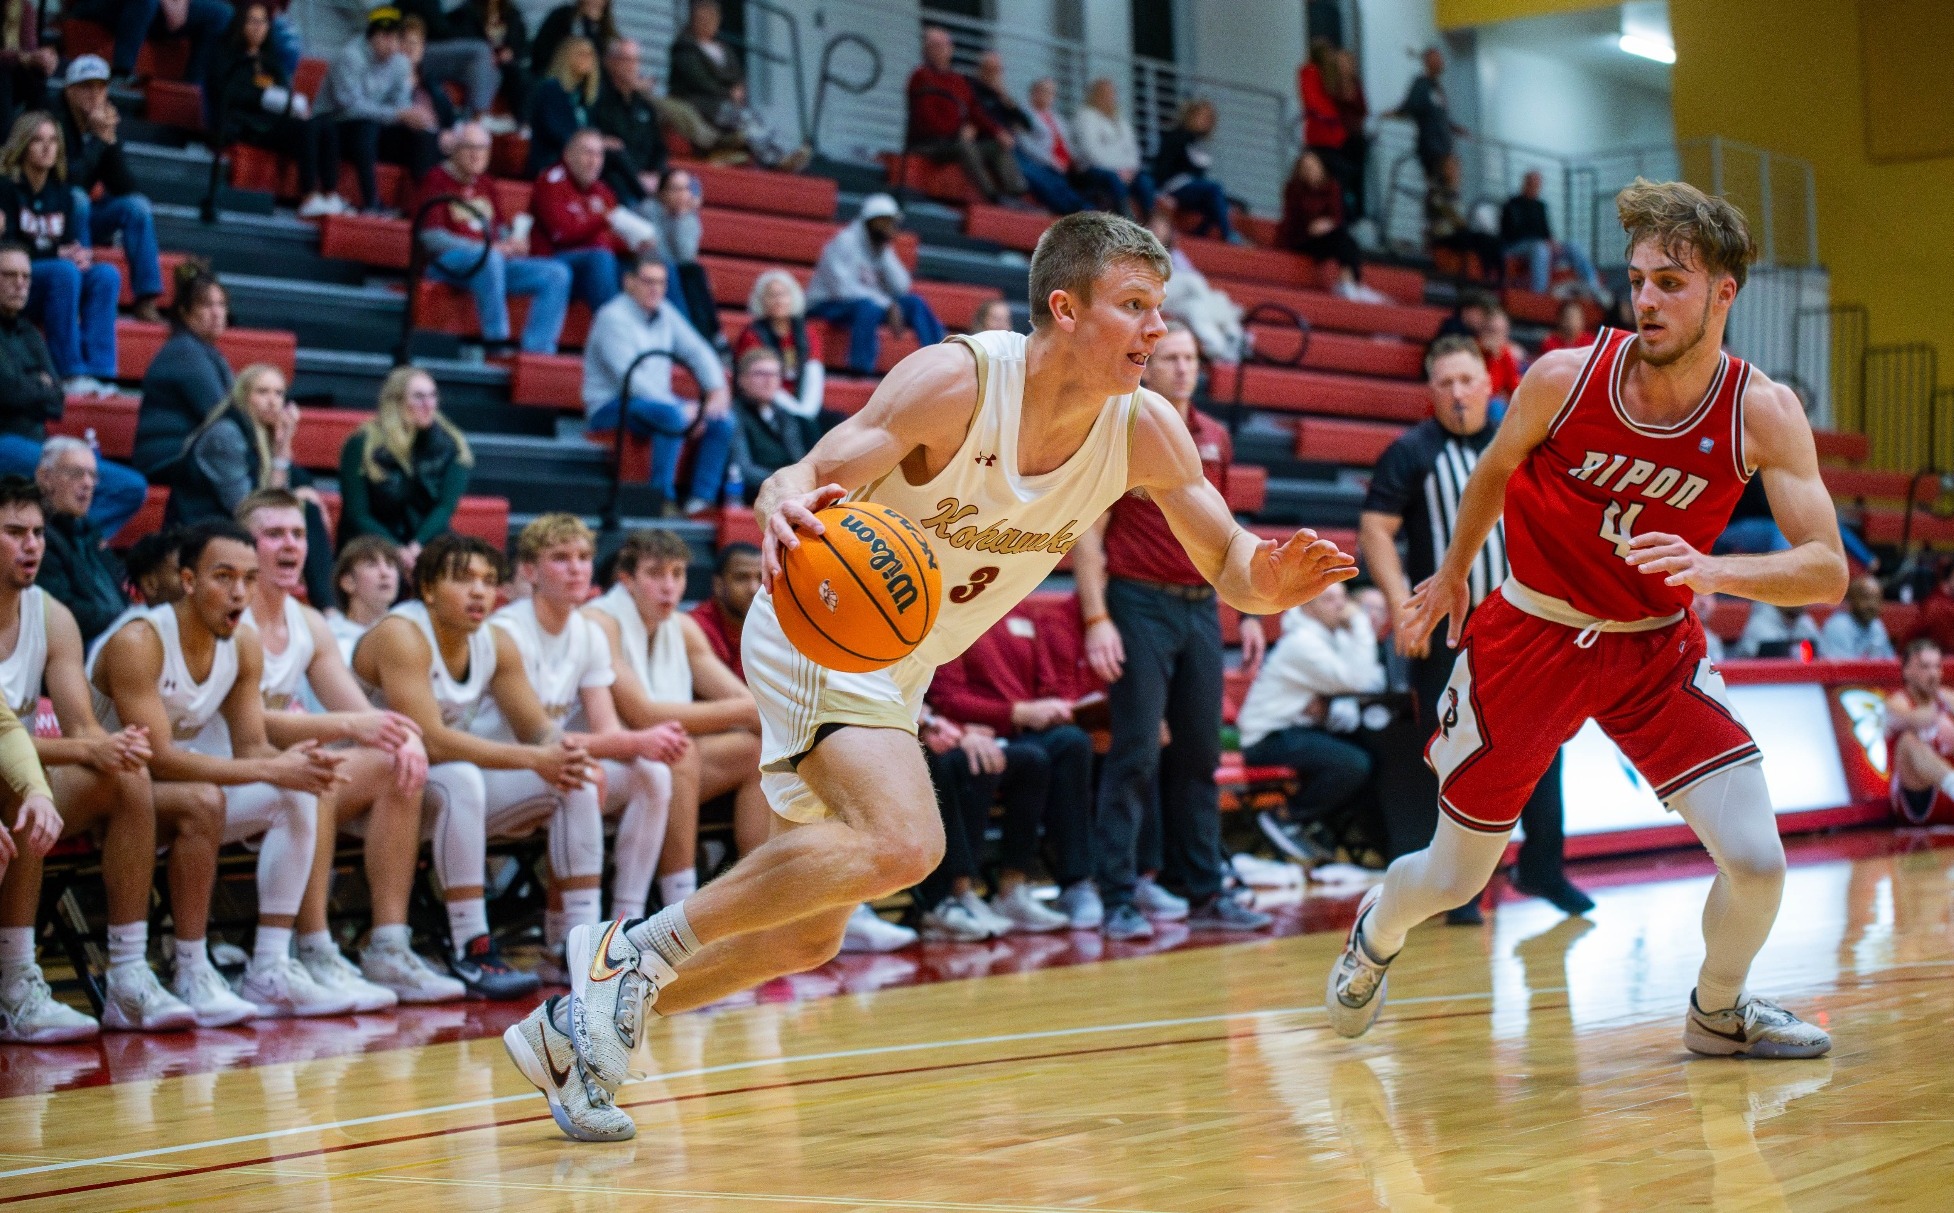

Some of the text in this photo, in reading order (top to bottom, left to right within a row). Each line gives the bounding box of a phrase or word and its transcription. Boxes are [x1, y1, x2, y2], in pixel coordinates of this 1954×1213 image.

[1567, 450, 1709, 510] RIPON
[883, 508, 939, 571] NCAA
[1599, 499, 1645, 559] 4
[840, 514, 918, 615] Wilson
[949, 566, 1000, 604] 3
